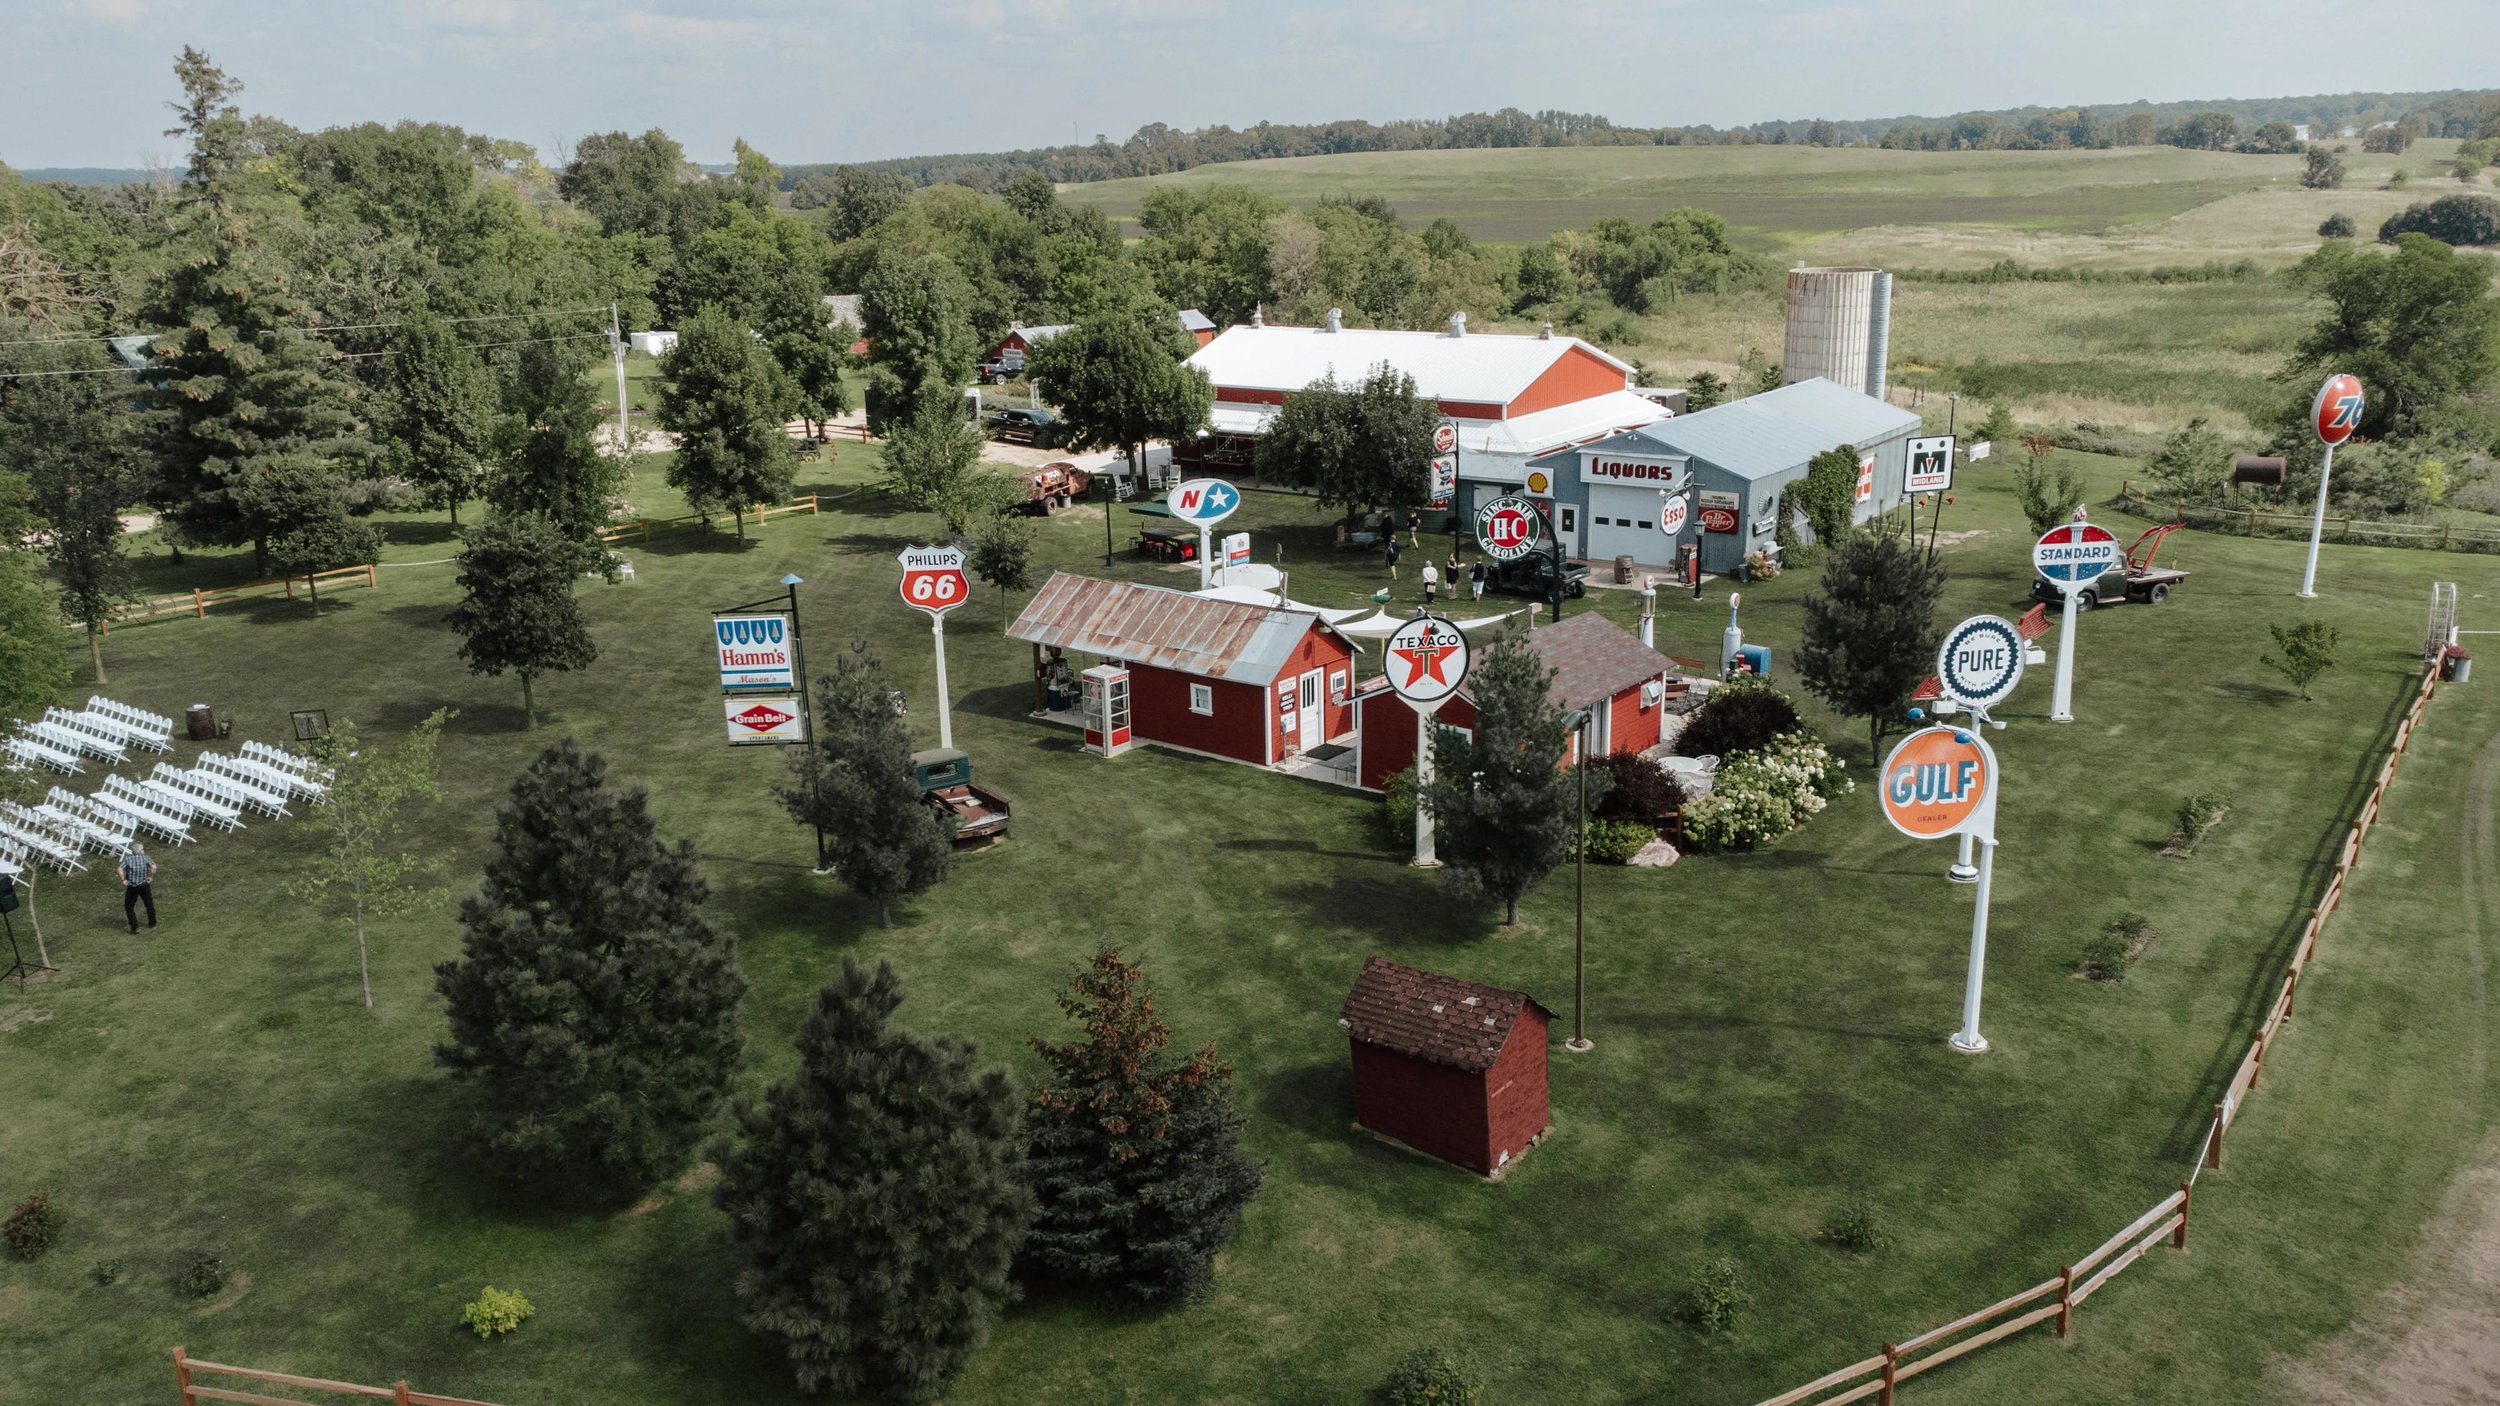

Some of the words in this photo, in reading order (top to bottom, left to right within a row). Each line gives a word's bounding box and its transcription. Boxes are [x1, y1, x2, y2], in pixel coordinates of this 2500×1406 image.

[2329, 395, 2364, 428] 76
[1912, 476, 1944, 486] MIDLAND
[1481, 500, 1534, 523] SINCAIR
[1481, 537, 1535, 558] GASOLINE
[2040, 546, 2111, 560] STANDARD
[907, 554, 958, 566] PHILLIPS
[912, 574, 957, 600] 66
[1397, 634, 1458, 648] TEXACO
[1964, 636, 1976, 645] BE
[1979, 633, 2001, 643] SURE
[722, 648, 786, 666] Hamm's
[1958, 648, 2005, 673] PURE
[1960, 675, 1977, 687] WITH
[1981, 672, 2001, 687] PURE
[735, 713, 764, 724] Grain
[764, 712, 786, 723] Belt
[1889, 760, 1979, 808] GULF
[1917, 814, 1948, 822] DEALER
